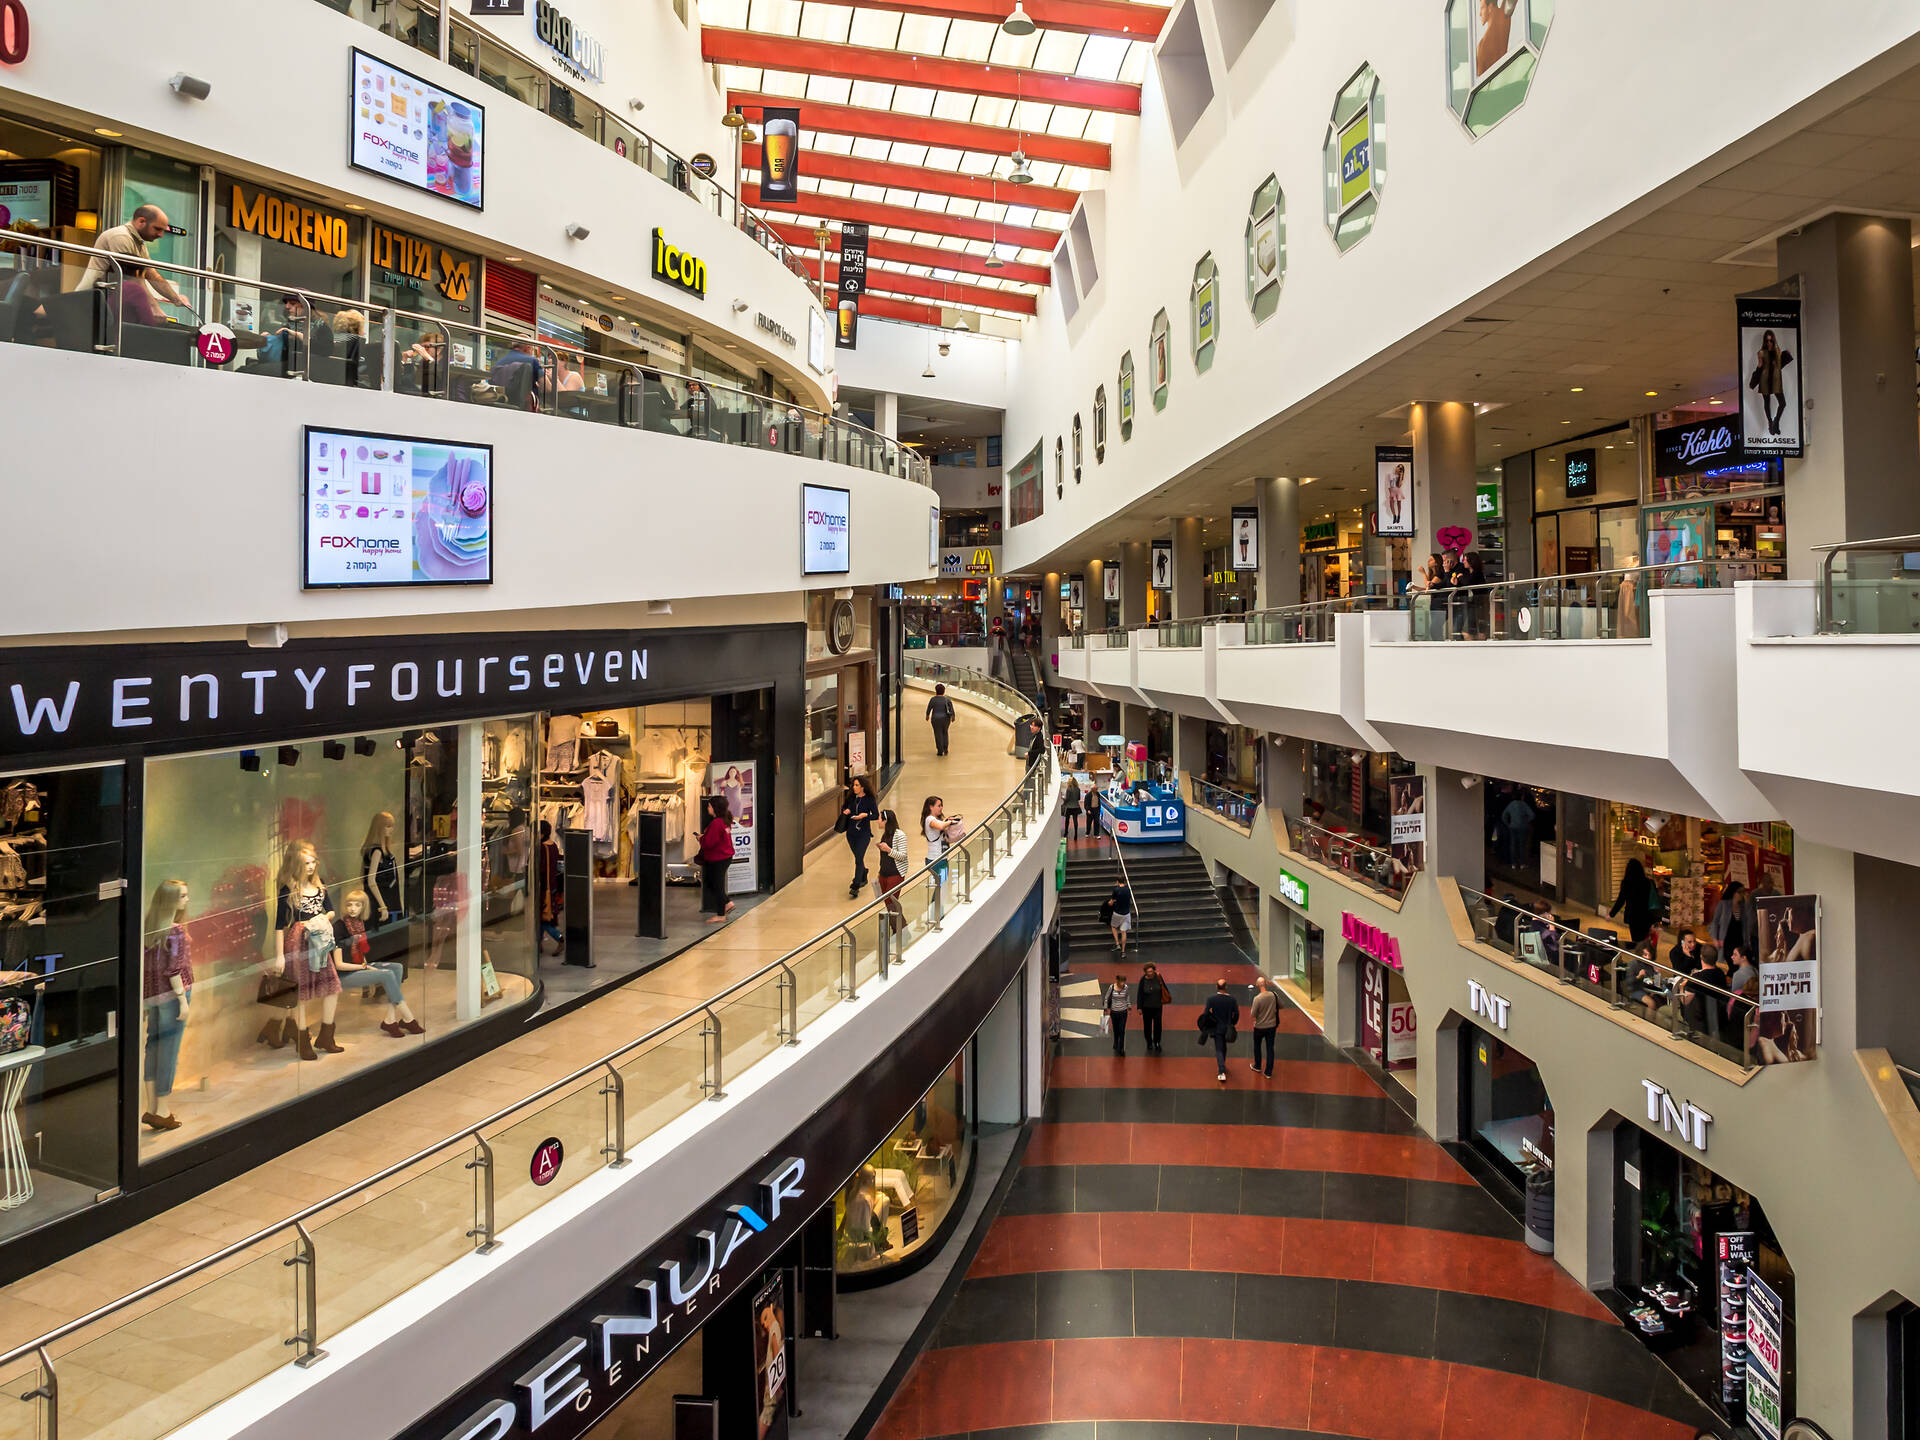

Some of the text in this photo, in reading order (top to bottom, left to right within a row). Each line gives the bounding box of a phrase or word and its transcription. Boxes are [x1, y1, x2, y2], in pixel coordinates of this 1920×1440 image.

[363, 132, 419, 161] FOXhome
[232, 184, 348, 259] MORENO
[373, 227, 433, 281] מורנו
[656, 227, 707, 294] icon
[844, 253, 864, 262] חיים
[207, 333, 223, 352] A
[1677, 426, 1732, 461] Kiehl's
[1747, 437, 1796, 445] SUNGLASSES
[1568, 460, 1588, 475] studio
[807, 511, 847, 526] FOXhome
[320, 536, 400, 549] FOXhome
[345, 561, 377, 572] בקומה 2
[735, 835, 751, 847] 50
[1393, 825, 1421, 835] חלונות
[1762, 980, 1811, 996] חלונות
[1467, 979, 1512, 1030] TNT
[1391, 1005, 1417, 1034] 50
[1641, 1078, 1713, 1151] TNT
[539, 1149, 552, 1175] A
[755, 1275, 782, 1308] RENUAR
[574, 1274, 721, 1413] CENTER
[769, 1352, 784, 1390] 20
